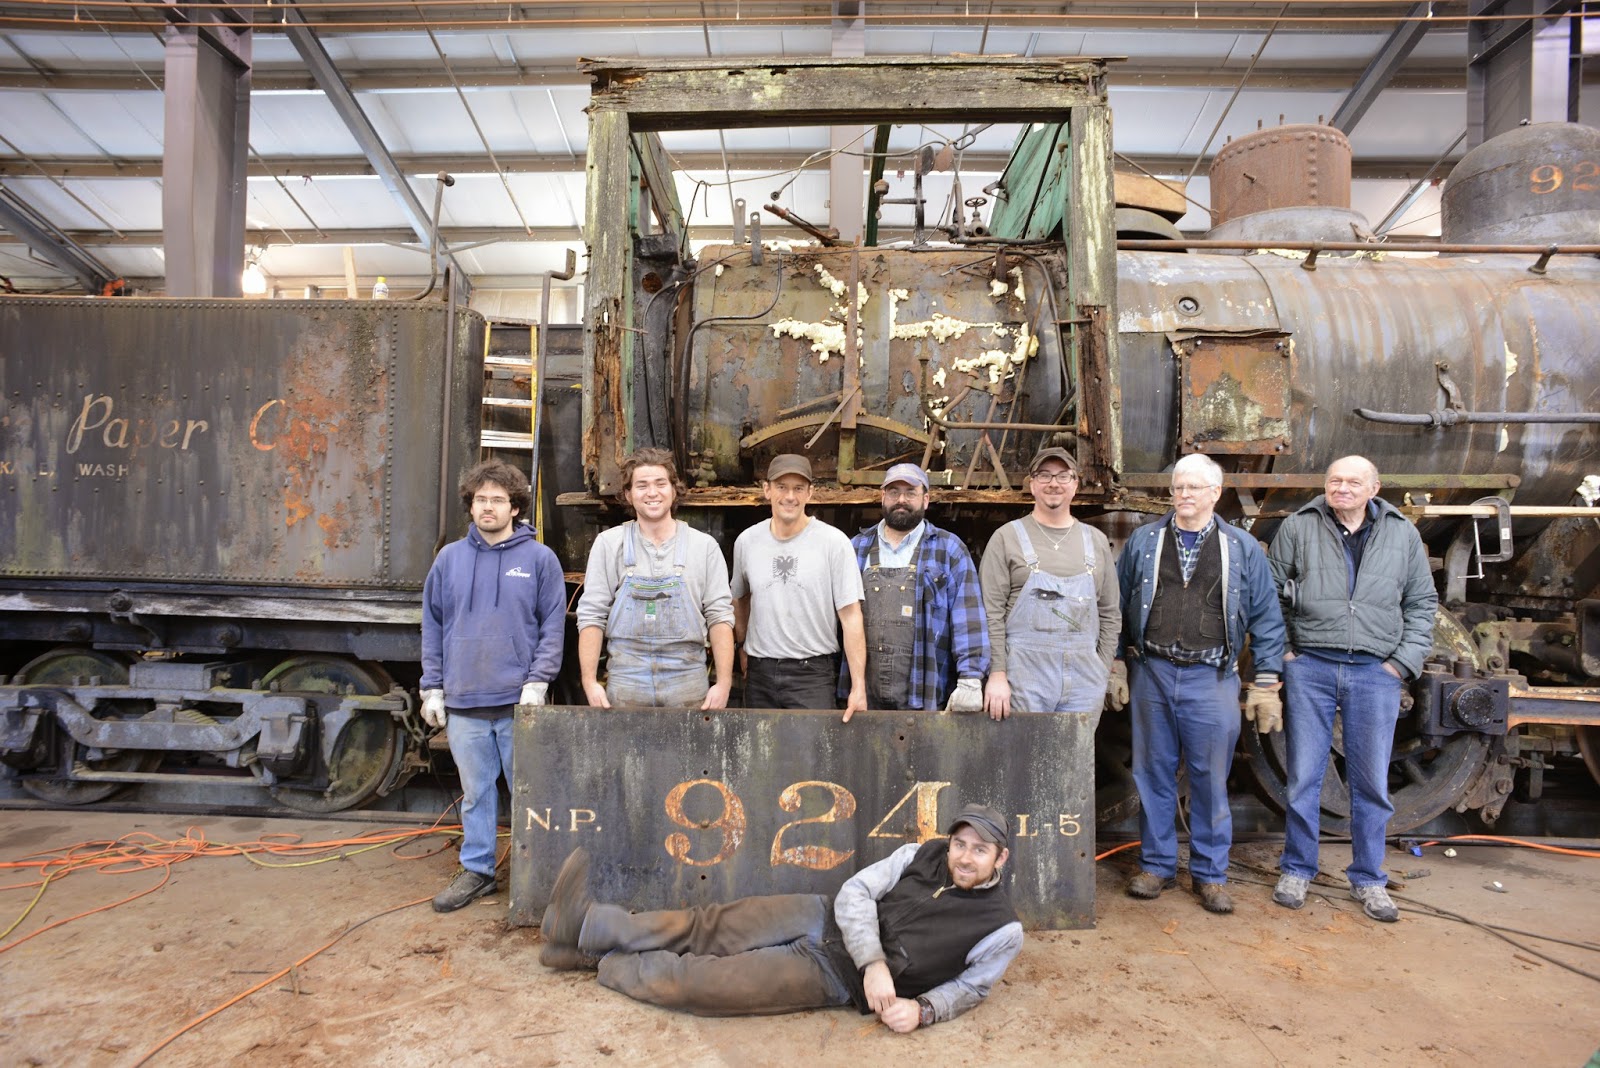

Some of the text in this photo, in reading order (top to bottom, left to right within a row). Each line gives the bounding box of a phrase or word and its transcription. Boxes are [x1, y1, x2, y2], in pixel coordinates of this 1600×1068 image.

[66, 393, 208, 459] Paper
[79, 463, 129, 476] WASH
[665, 779, 951, 870] 924
[1016, 813, 1081, 837] L-5
